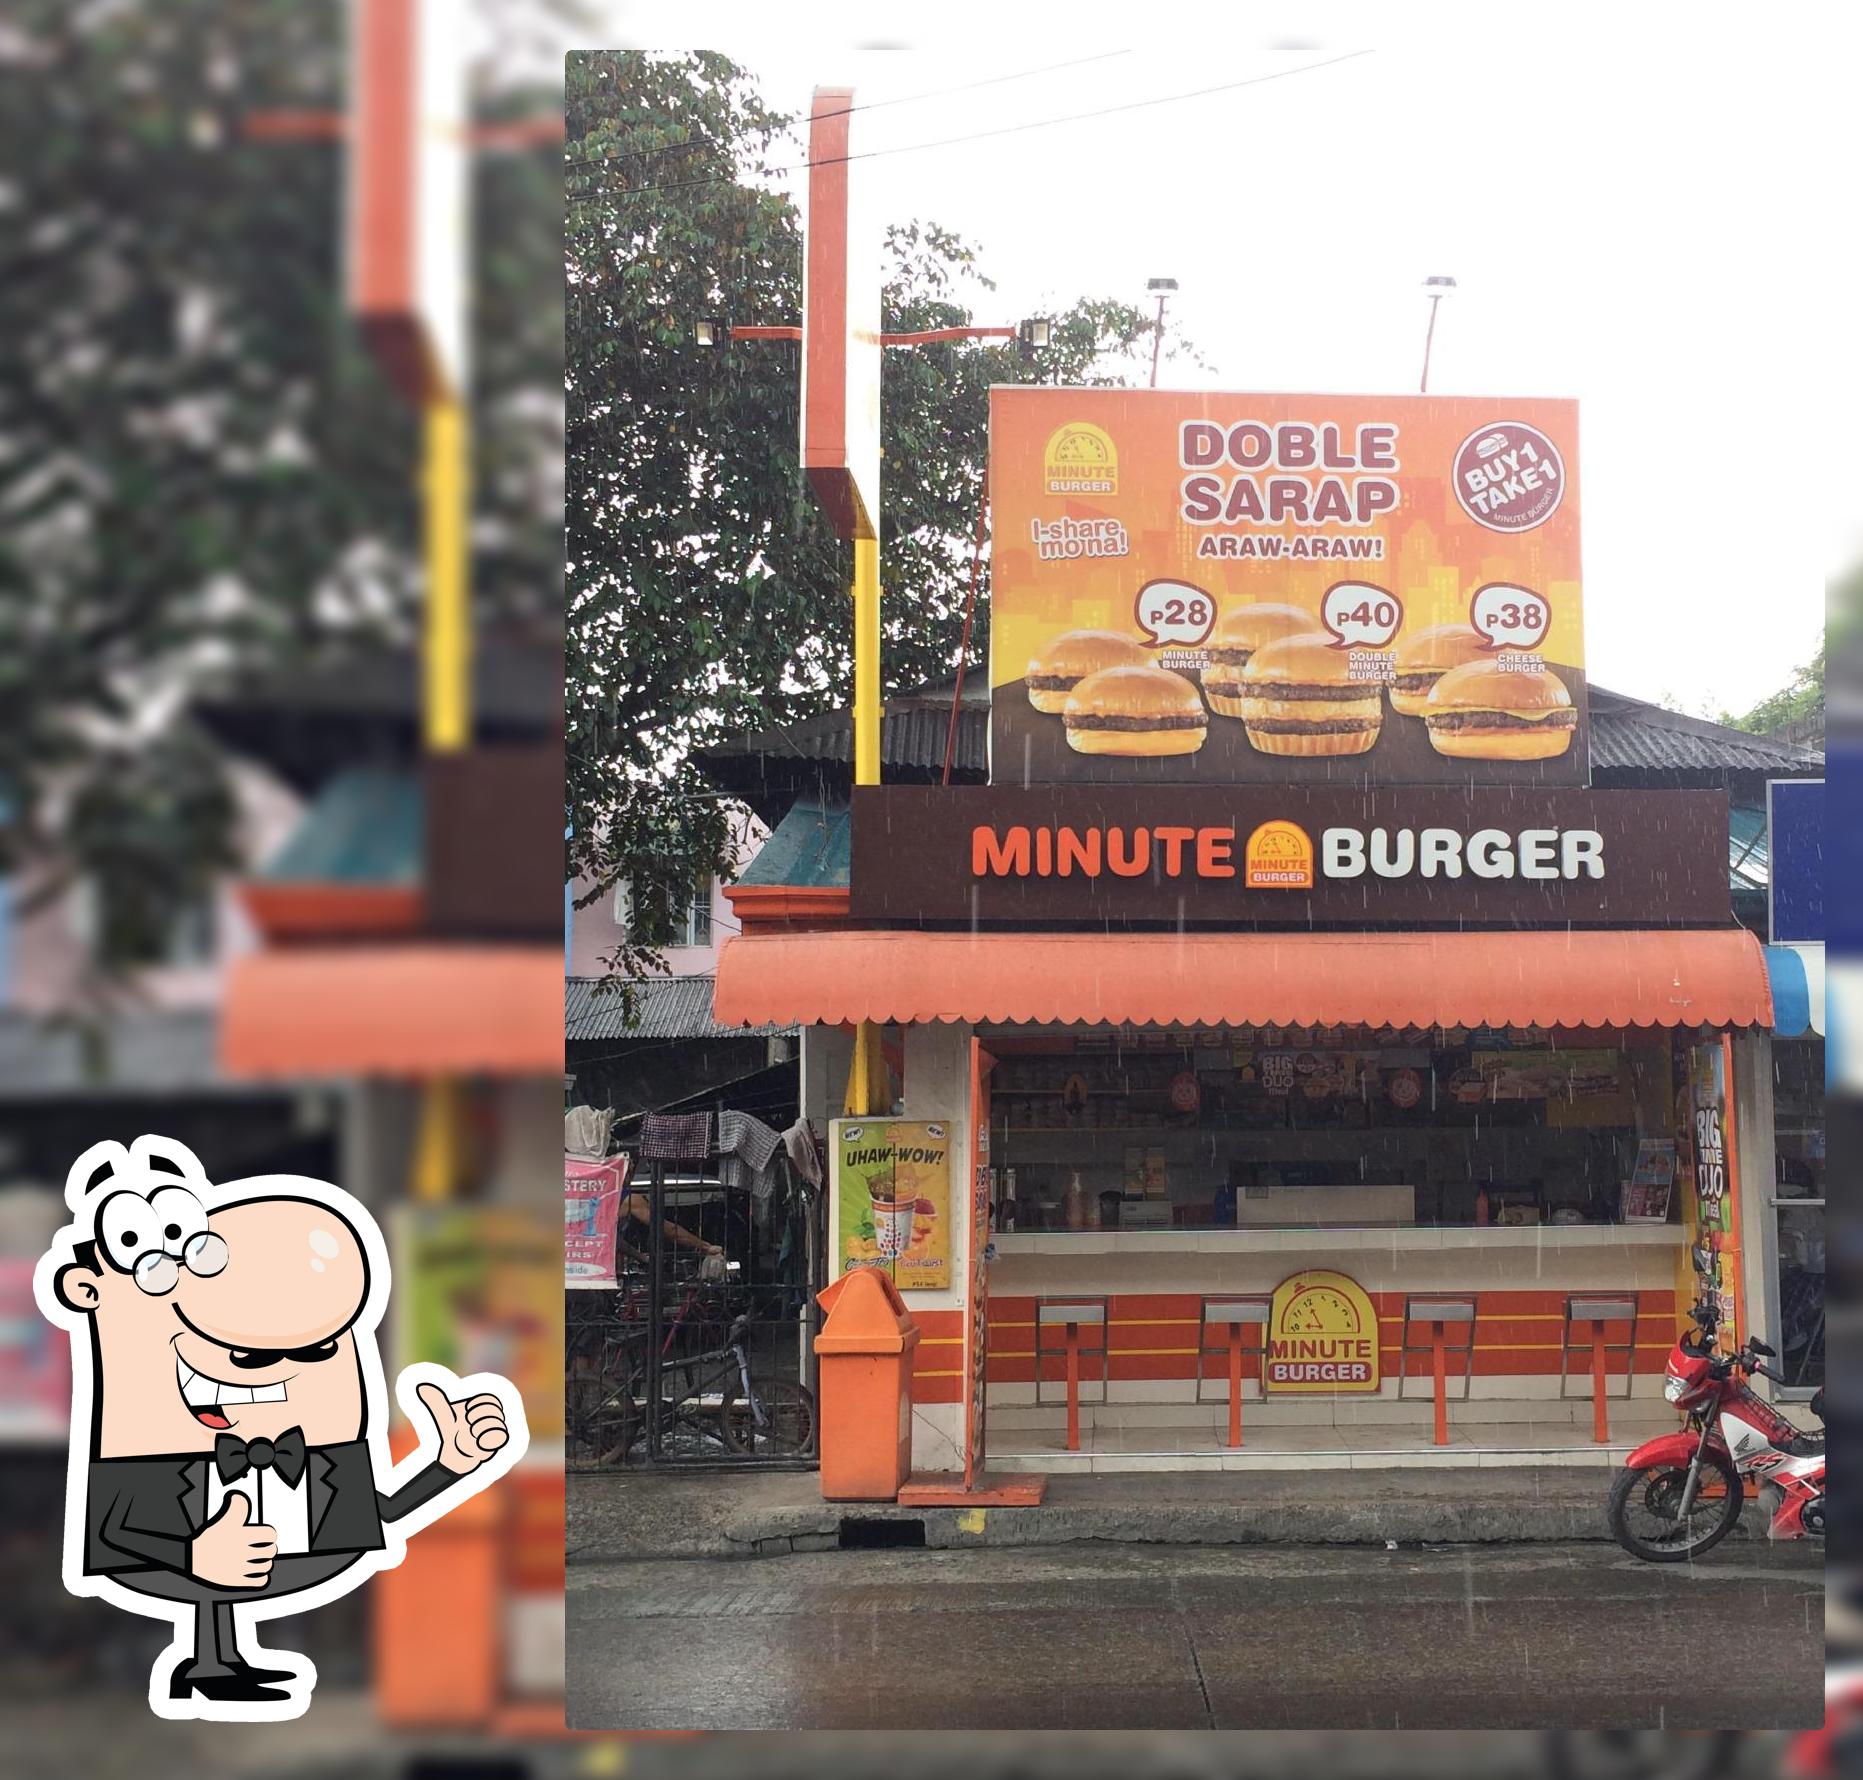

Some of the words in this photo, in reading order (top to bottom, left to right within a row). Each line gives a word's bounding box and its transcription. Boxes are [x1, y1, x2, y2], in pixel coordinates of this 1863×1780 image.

[1182, 422, 1398, 470] DOBLE
[1046, 465, 1115, 478] MINUTE
[1464, 449, 1520, 492] BUY
[1520, 441, 1538, 463] 1
[1050, 480, 1112, 492] BURGER
[1469, 466, 1543, 514] TAKE
[1538, 458, 1557, 480] 1
[1183, 475, 1397, 523] SARAP
[1493, 511, 1528, 523] MINUTE
[1526, 487, 1554, 519] BURGER
[1032, 518, 1120, 541] I-share
[1199, 536, 1383, 559] ARAW-ARAW!
[1150, 599, 1208, 626] P28
[1336, 601, 1395, 628] P40
[1486, 603, 1542, 630] P38
[1162, 650, 1208, 660] MINUTE
[1348, 652, 1396, 661] DOUBLE
[1497, 654, 1543, 663] CHEESE
[1162, 660, 1210, 669] BURGER
[1348, 661, 1394, 670] MINUTE
[1497, 663, 1546, 673] BURGER
[1348, 671, 1397, 680] BURGER
[972, 826, 1236, 878] MINUTE
[1322, 828, 1605, 880] BURGER
[1250, 859, 1308, 870] MINUTE
[1253, 872, 1306, 882] BURGER
[1696, 1110, 1722, 1149] BIG
[847, 1147, 945, 1167] UHAW-WOW!
[1303, 1298, 1313, 1308] 12
[1332, 1299, 1340, 1308] 2
[1293, 1309, 1303, 1318] 11
[1291, 1323, 1301, 1332] 10
[1269, 1340, 1372, 1359] MINUTE
[1273, 1363, 1366, 1381] BURGER
